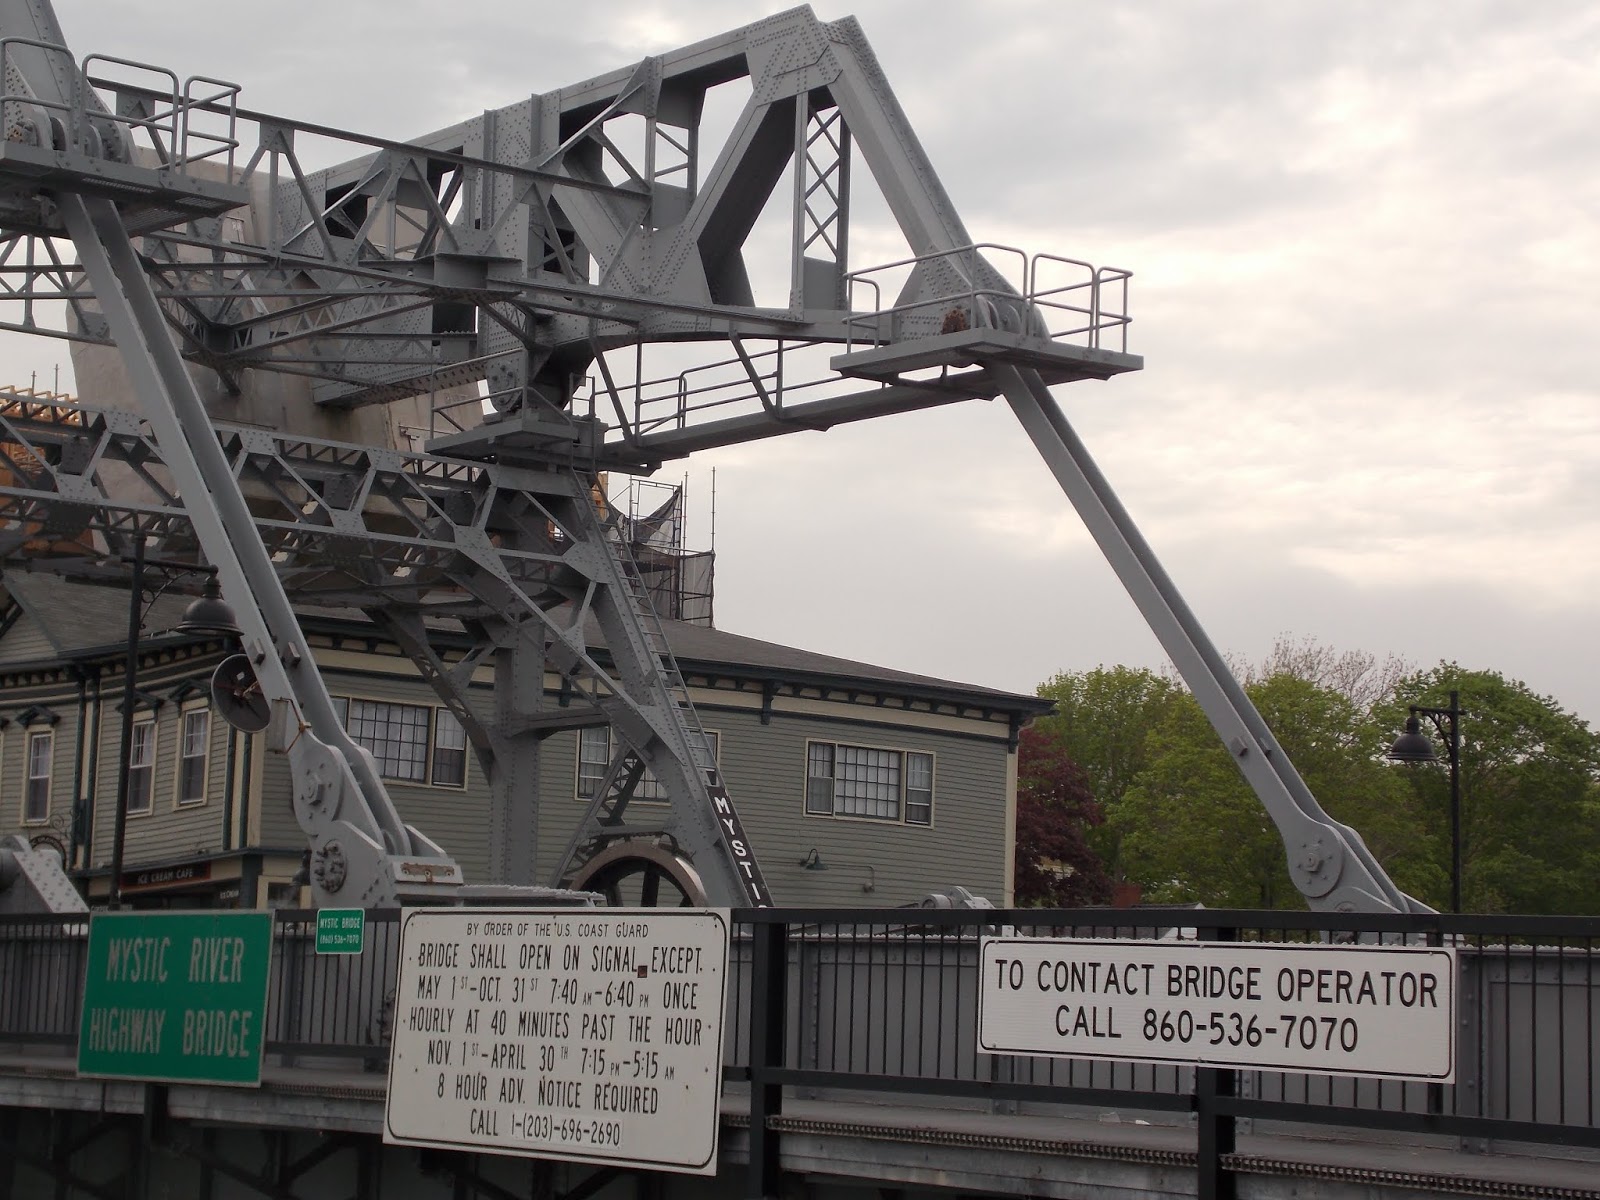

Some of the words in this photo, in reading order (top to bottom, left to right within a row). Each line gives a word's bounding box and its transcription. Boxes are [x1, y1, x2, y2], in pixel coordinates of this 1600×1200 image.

[714, 796, 767, 908] MYSTI
[138, 875, 147, 884] ICE
[151, 871, 173, 883] CREAM
[176, 868, 193, 879] CAFE
[320, 917, 338, 928] MYSTIC
[342, 917, 360, 928] BRIDGE
[466, 923, 480, 936] BY
[484, 922, 512, 937] ORDER
[517, 923, 529, 937] OF
[535, 923, 551, 937] THE
[556, 923, 572, 937] U.S.
[578, 923, 611, 938] COAST
[615, 922, 649, 938] GUARD
[106, 937, 171, 983] MYSTIC
[188, 937, 245, 983] RIVER
[418, 943, 460, 969] BRIDGE
[470, 944, 507, 970] SHALL
[519, 945, 551, 971] OPEN
[563, 946, 579, 971] ON
[417, 975, 441, 1000] MAY
[663, 981, 698, 1010] ONCE
[995, 959, 1024, 991] TO
[1037, 960, 1154, 997] CONTACT
[1167, 964, 1262, 1000] BRIDGE
[1277, 967, 1438, 1008] OPERATOR
[88, 1008, 166, 1055] HIGHWAY
[182, 1009, 252, 1058] BRIDGE
[409, 1007, 454, 1033] HOURLY
[465, 1009, 480, 1035] AT
[491, 1010, 507, 1036] 40
[518, 1011, 569, 1039] MINUTES
[582, 1014, 615, 1042] PAST
[629, 1015, 651, 1043] THE
[665, 1017, 702, 1046] HOUR
[1055, 1005, 1122, 1039] CALL
[1142, 1008, 1359, 1053] 860-536-7070
[427, 1040, 452, 1066] NOV.
[437, 1073, 445, 1098] 8
[456, 1073, 487, 1102] HOUR
[499, 1076, 526, 1105] ADV.
[538, 1078, 582, 1109] NOTICE
[594, 1082, 658, 1115] REQUIRED
[470, 1108, 498, 1136] CALL
[511, 1114, 621, 1147] 1-(203)-696-2690
